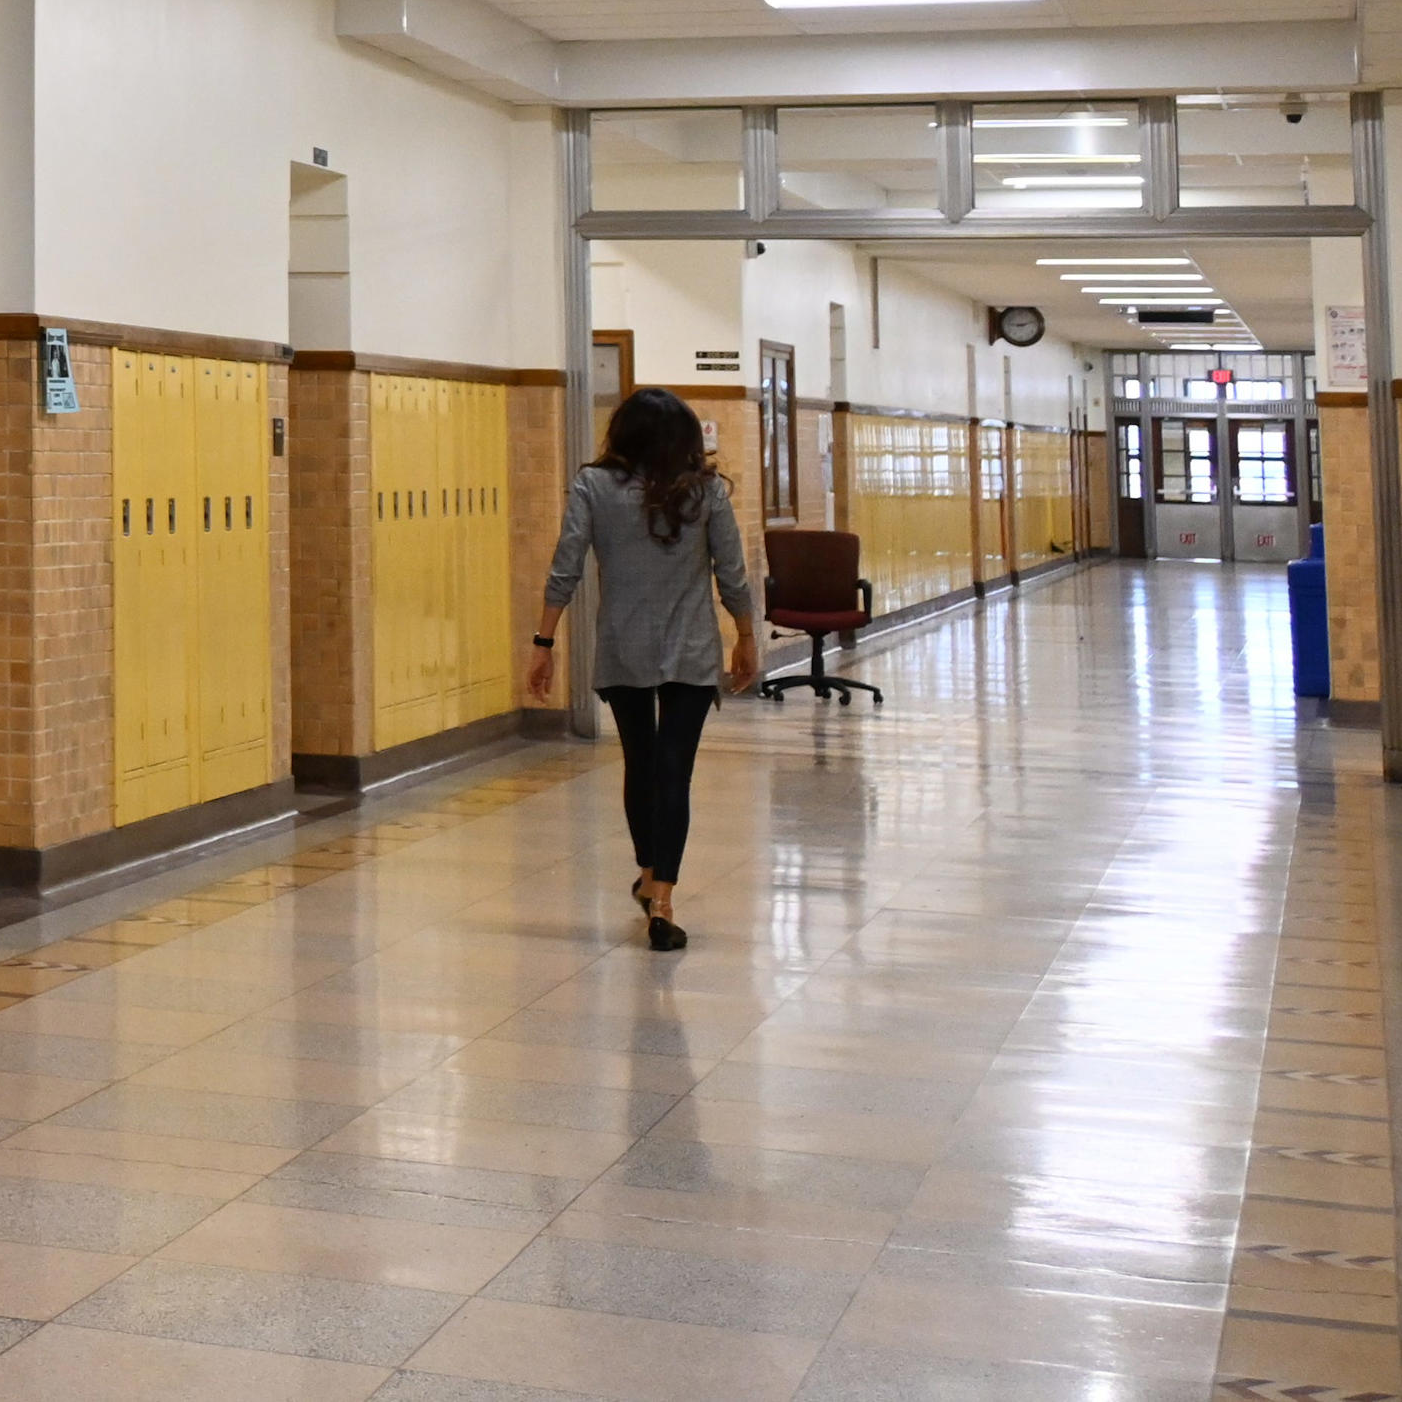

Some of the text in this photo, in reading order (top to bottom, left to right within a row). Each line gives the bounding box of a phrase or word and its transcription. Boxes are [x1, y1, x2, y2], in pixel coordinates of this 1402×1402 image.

[1211, 370, 1232, 384] EXIT
[1179, 532, 1197, 545] EXIT
[1256, 534, 1276, 547] EXIT
